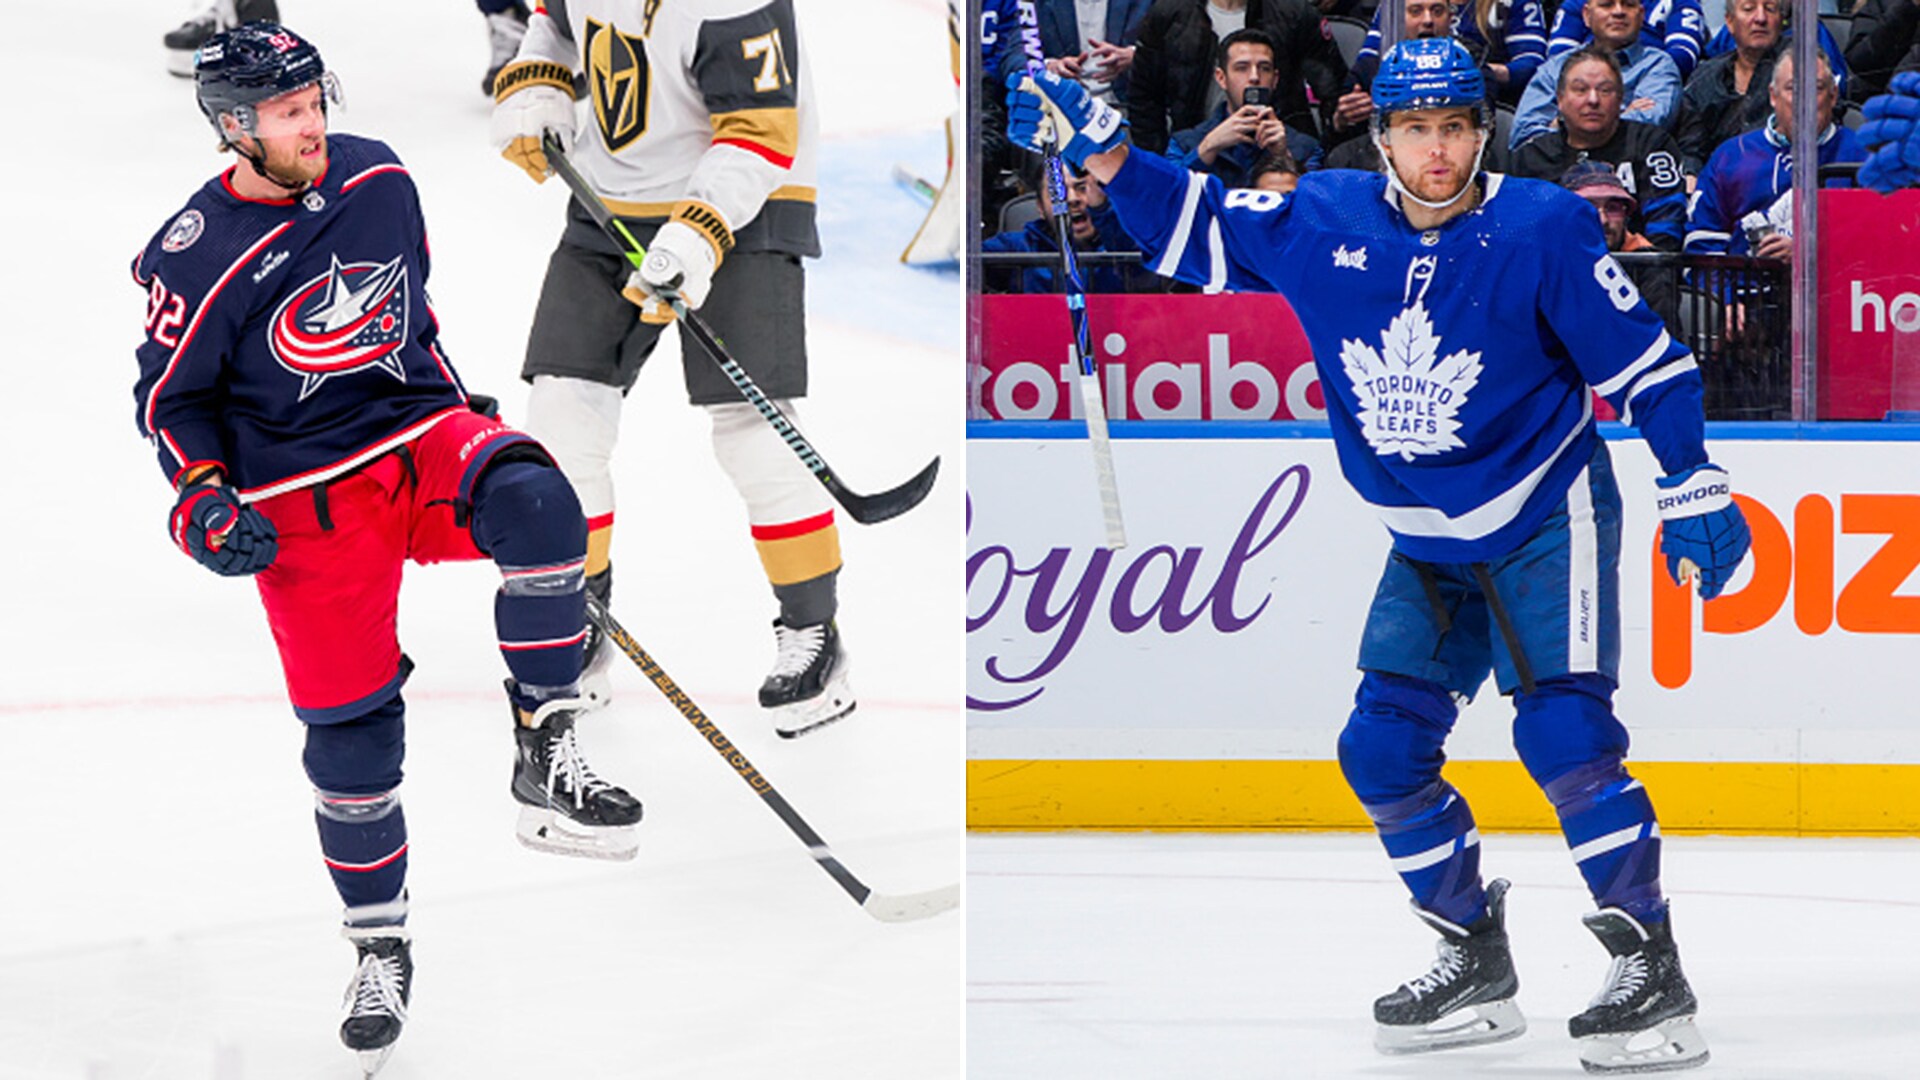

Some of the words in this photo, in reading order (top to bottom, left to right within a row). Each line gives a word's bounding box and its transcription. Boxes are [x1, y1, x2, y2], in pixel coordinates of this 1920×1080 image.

[496, 63, 573, 97] WARRIO
[1363, 374, 1453, 406] TORONTO
[1377, 396, 1438, 417] MAPLE
[1376, 415, 1438, 435] LEAFS
[966, 463, 1312, 711] oyal
